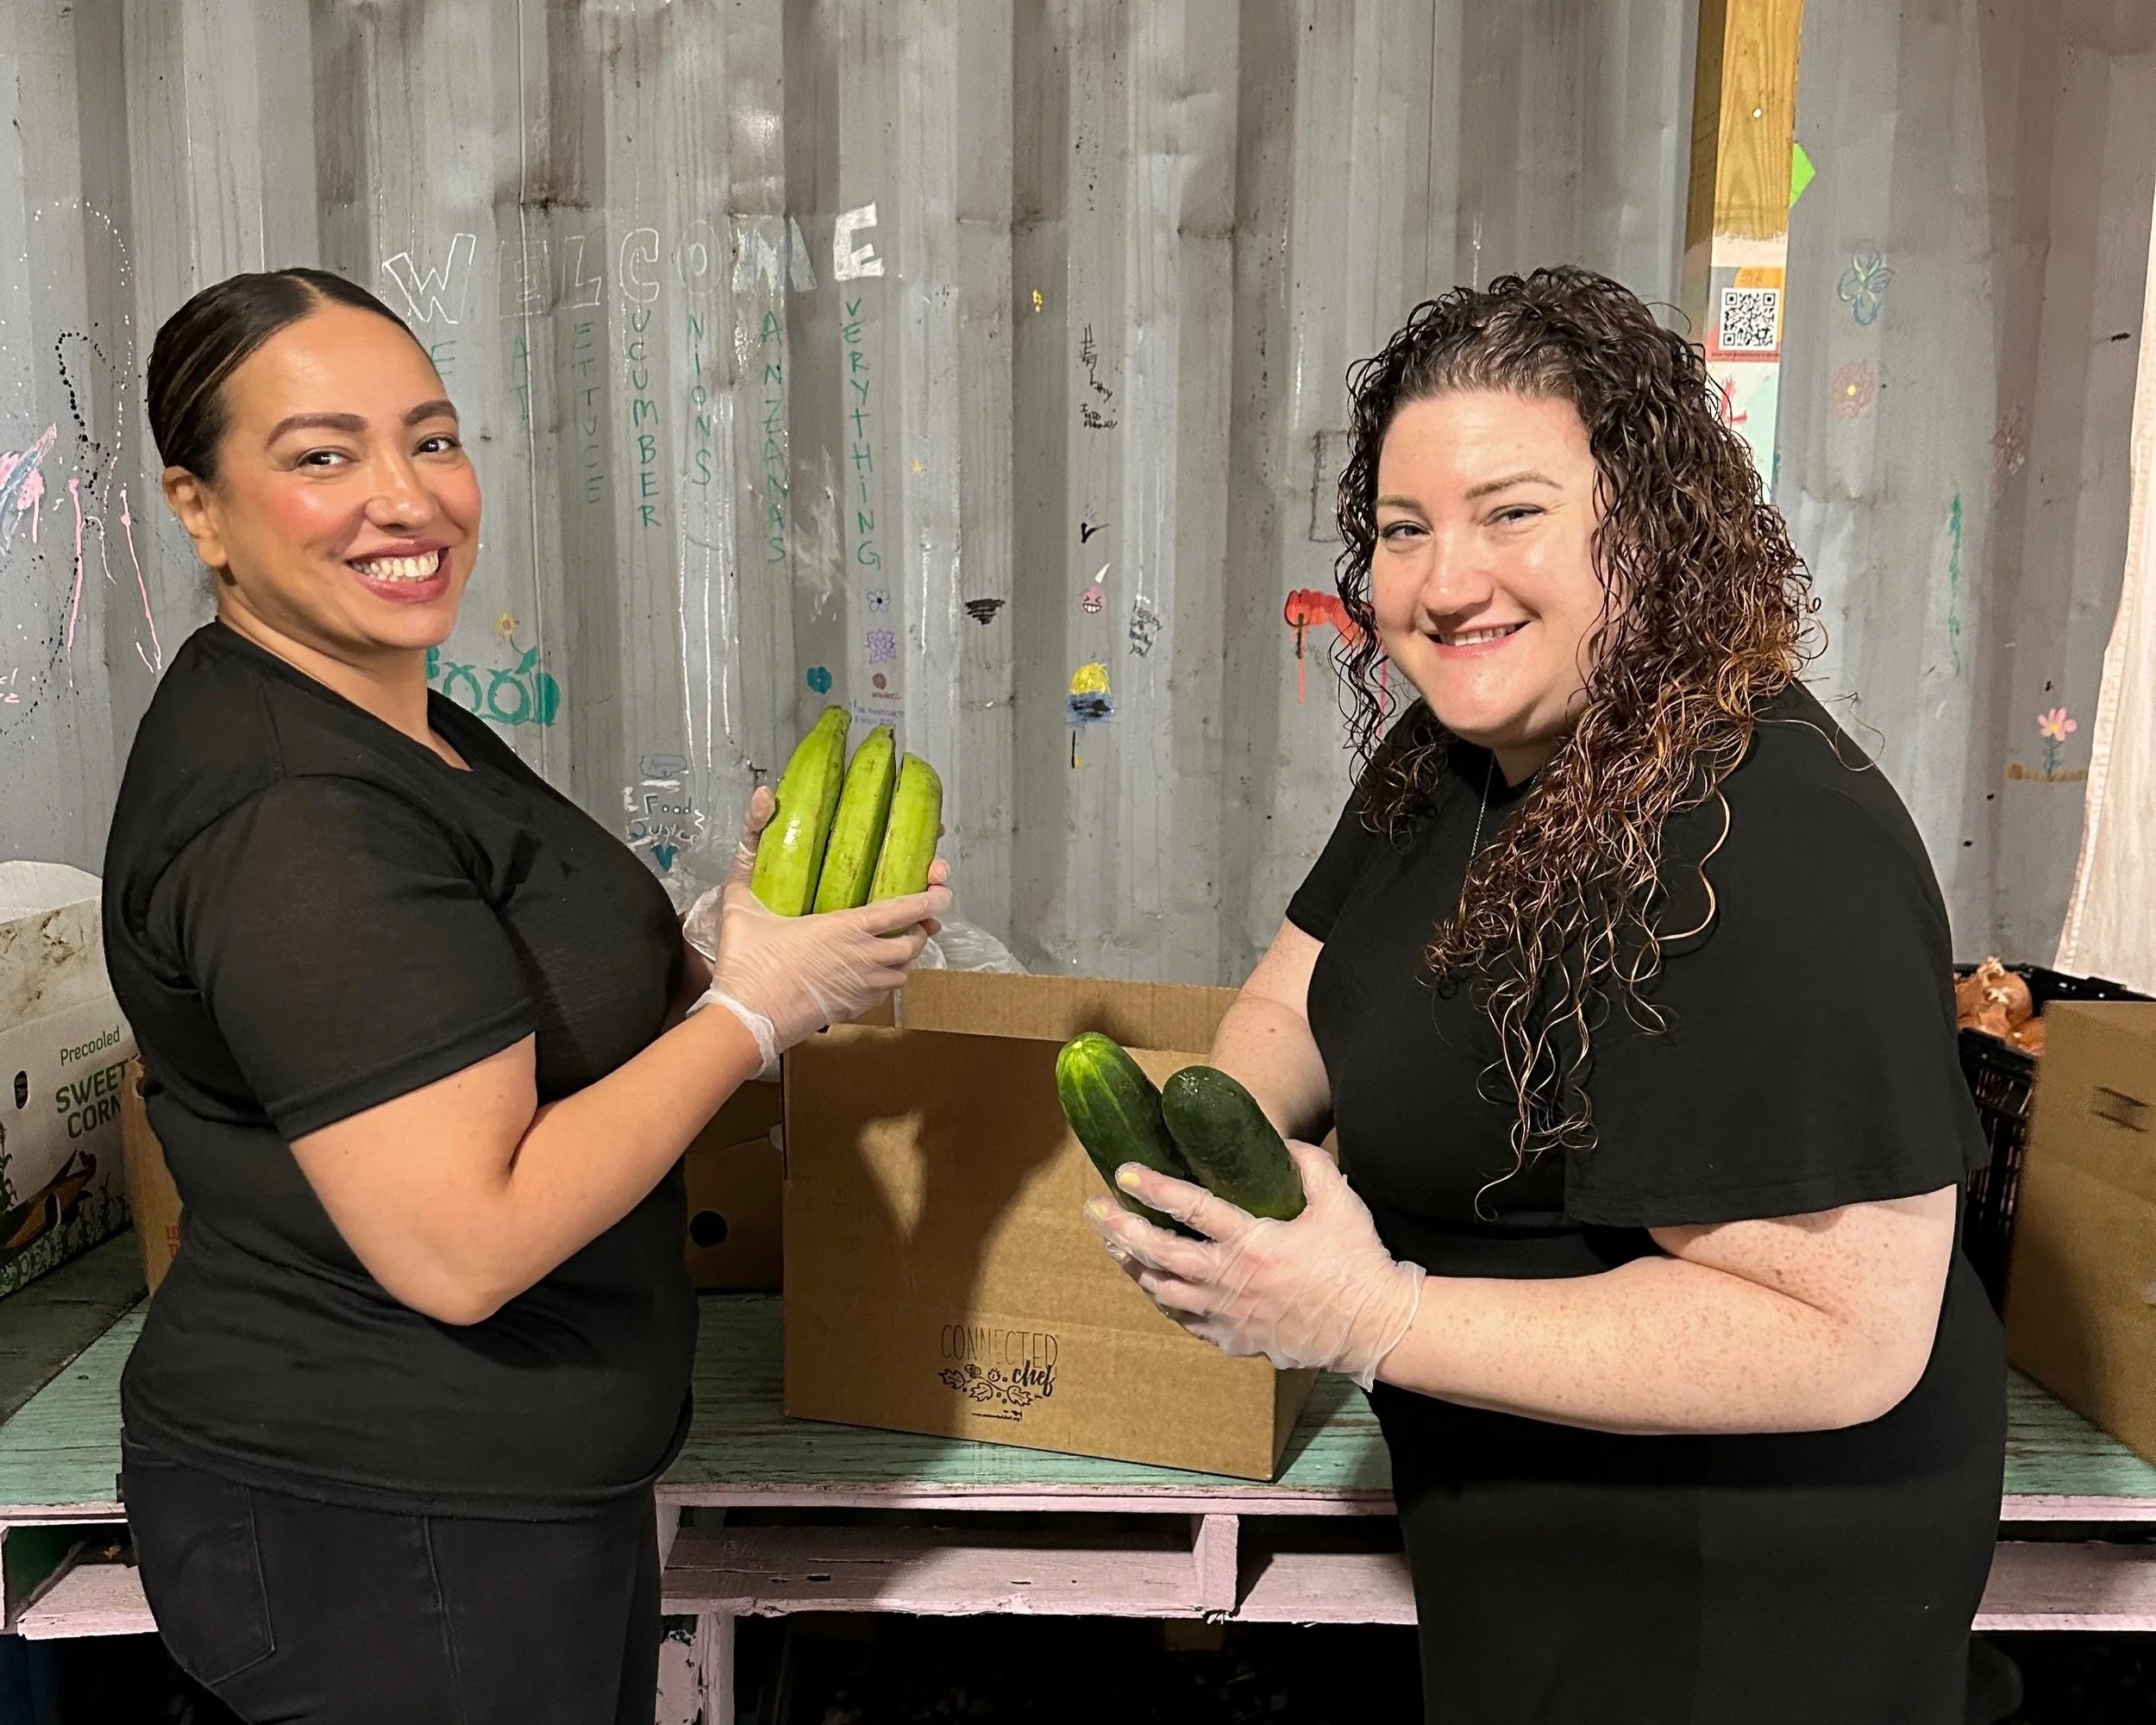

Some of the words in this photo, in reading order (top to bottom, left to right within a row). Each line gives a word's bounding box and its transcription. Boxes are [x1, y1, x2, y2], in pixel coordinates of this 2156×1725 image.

[380, 204, 887, 324] WELCOME
[629, 310, 662, 529] UCUMBER
[688, 311, 711, 486] NIONS
[643, 793, 692, 814] Food
[60, 1024, 121, 1067] Precooled
[54, 1057, 129, 1114] SWEET
[941, 1324, 1058, 1369] CONNECTED
[1011, 1359, 1056, 1397] chef
